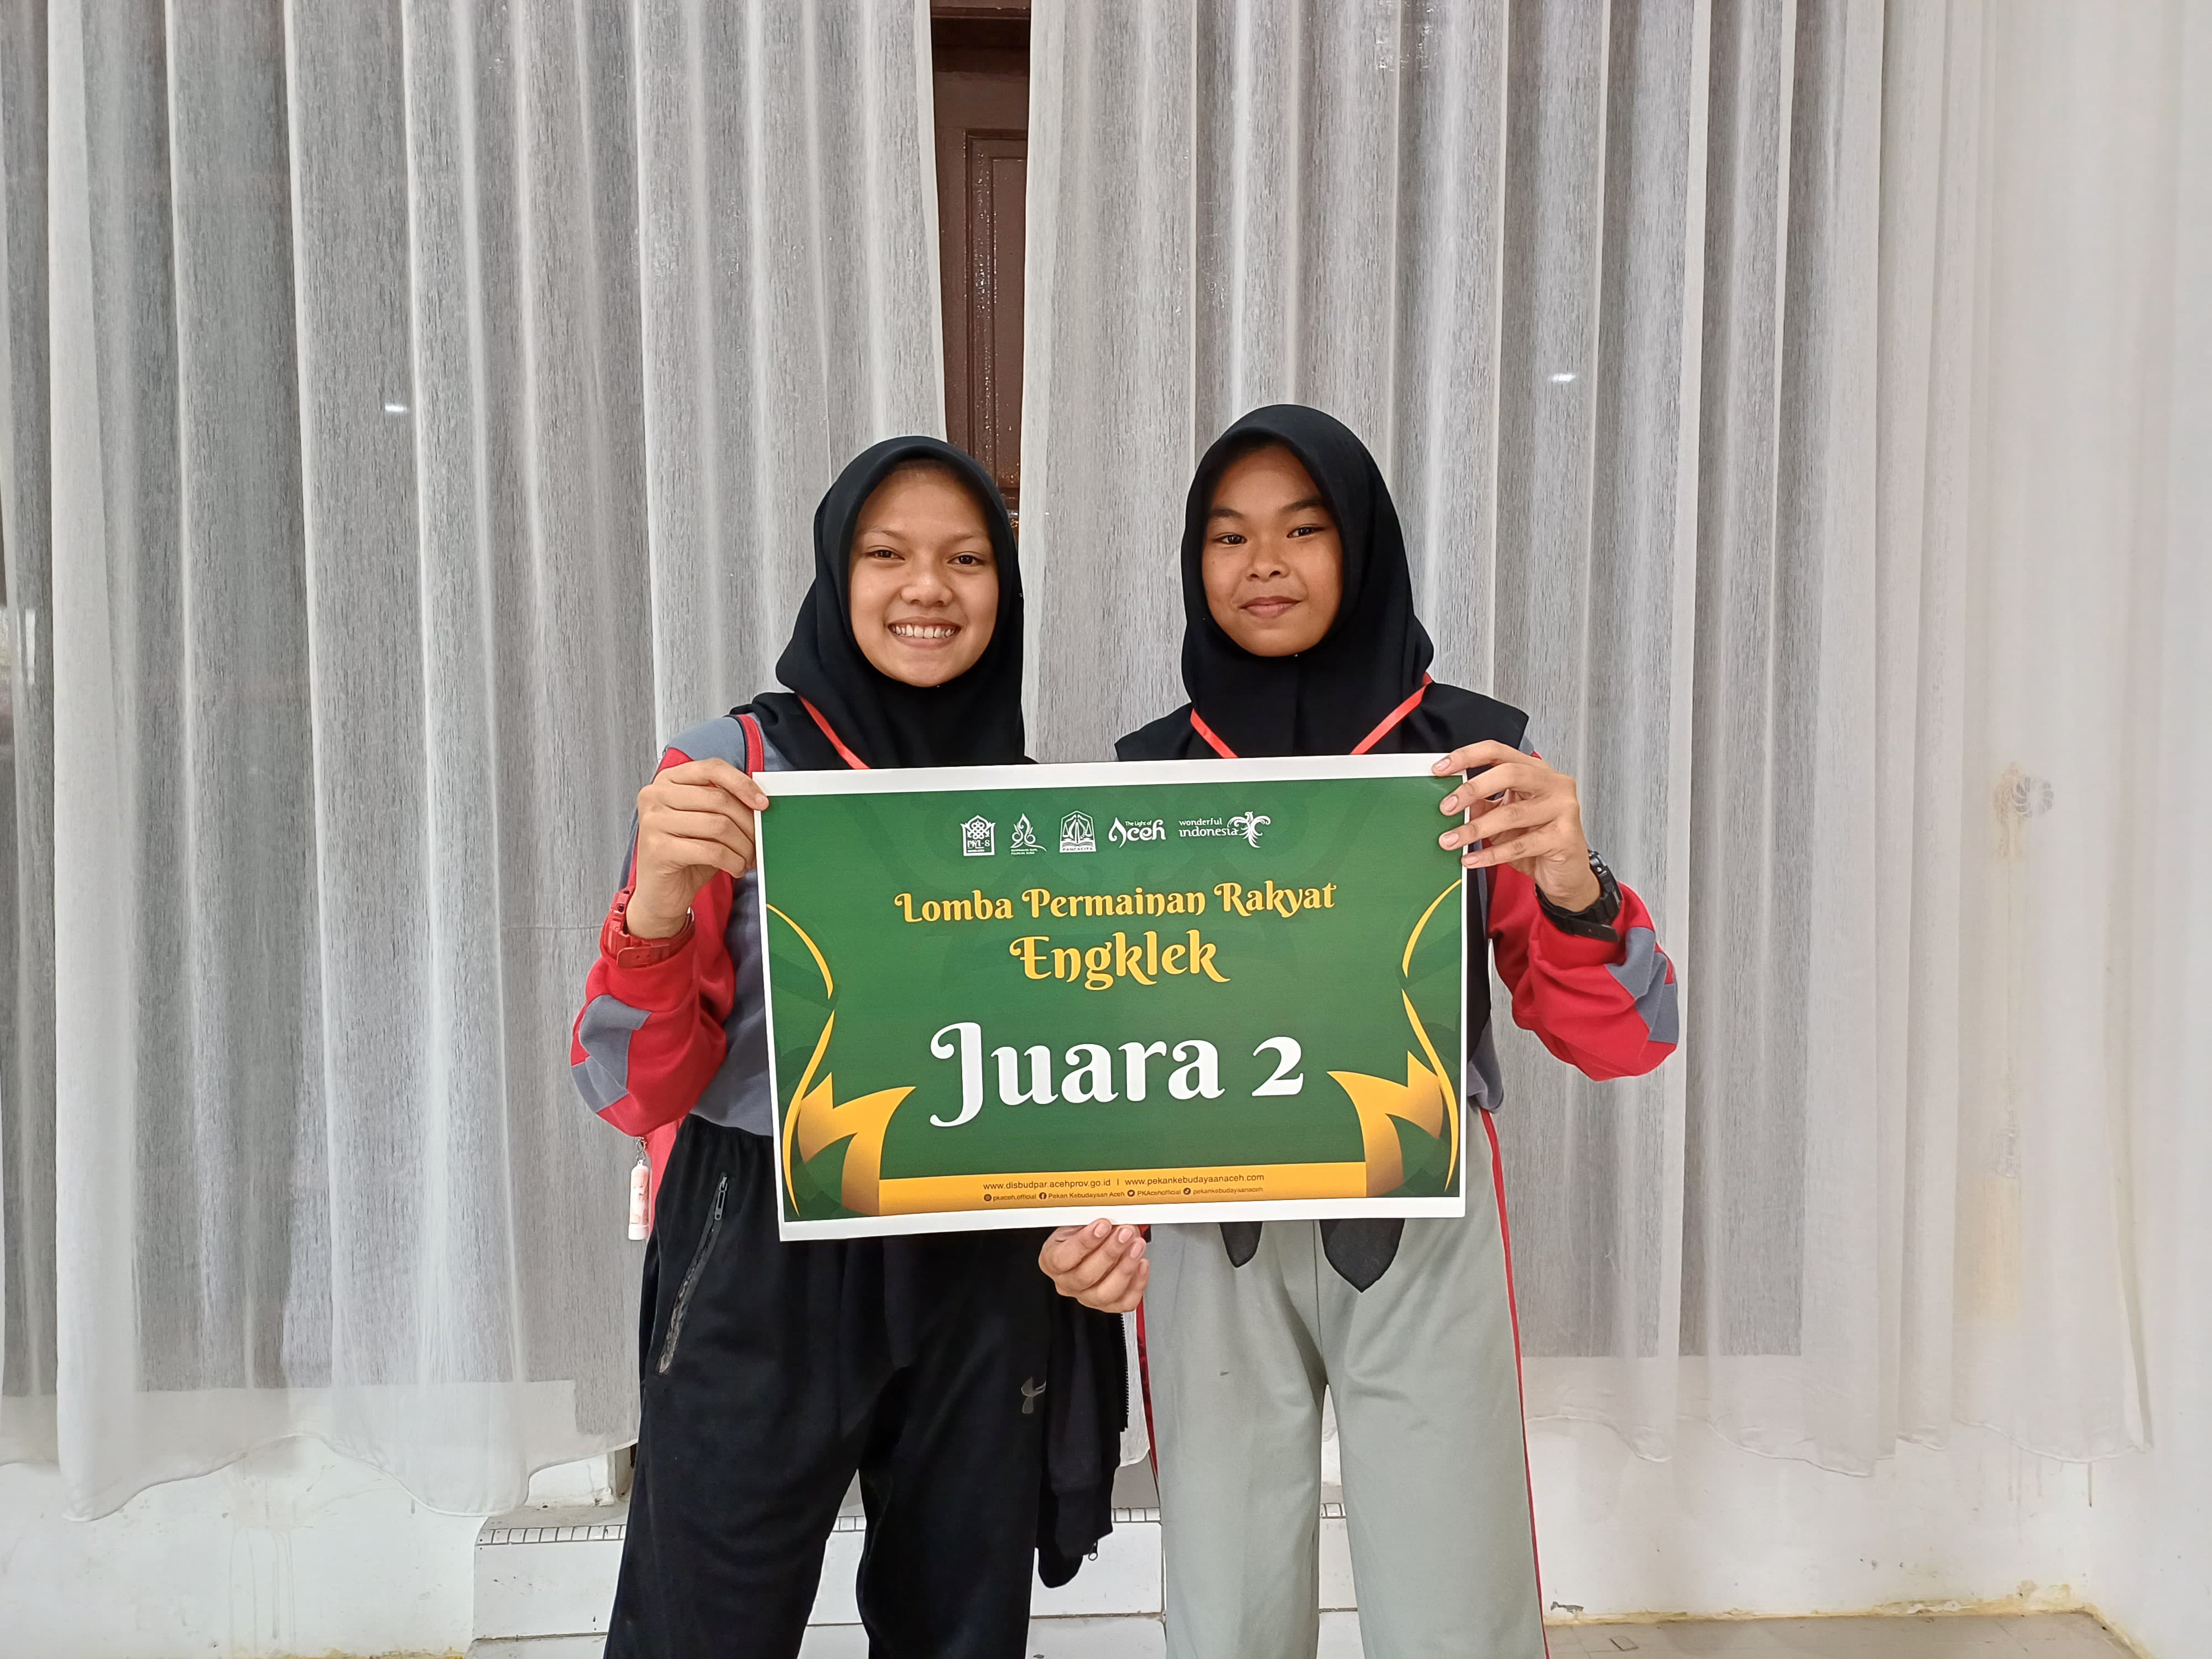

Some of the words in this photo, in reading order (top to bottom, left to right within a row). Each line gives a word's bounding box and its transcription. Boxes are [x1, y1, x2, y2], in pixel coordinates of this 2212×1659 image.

[1108, 817, 1166, 848] Aceh
[1178, 817, 1223, 826] wonderful
[1178, 826, 1239, 837] indonesia
[894, 889, 1014, 923] Lomba
[1021, 887, 1206, 919] Permainan
[1213, 880, 1338, 919] Rakyat
[1009, 929, 1231, 991] Engklek
[930, 1022, 1225, 1127] Juara
[1251, 1036, 1303, 1097] 2
[983, 1178, 1110, 1190] www.disbudpar.acehprov.go.id
[1124, 1174, 1265, 1186] www.pekankebudayaanaceh.com
[1193, 1187, 1263, 1195] pekankebudayaanaceh
